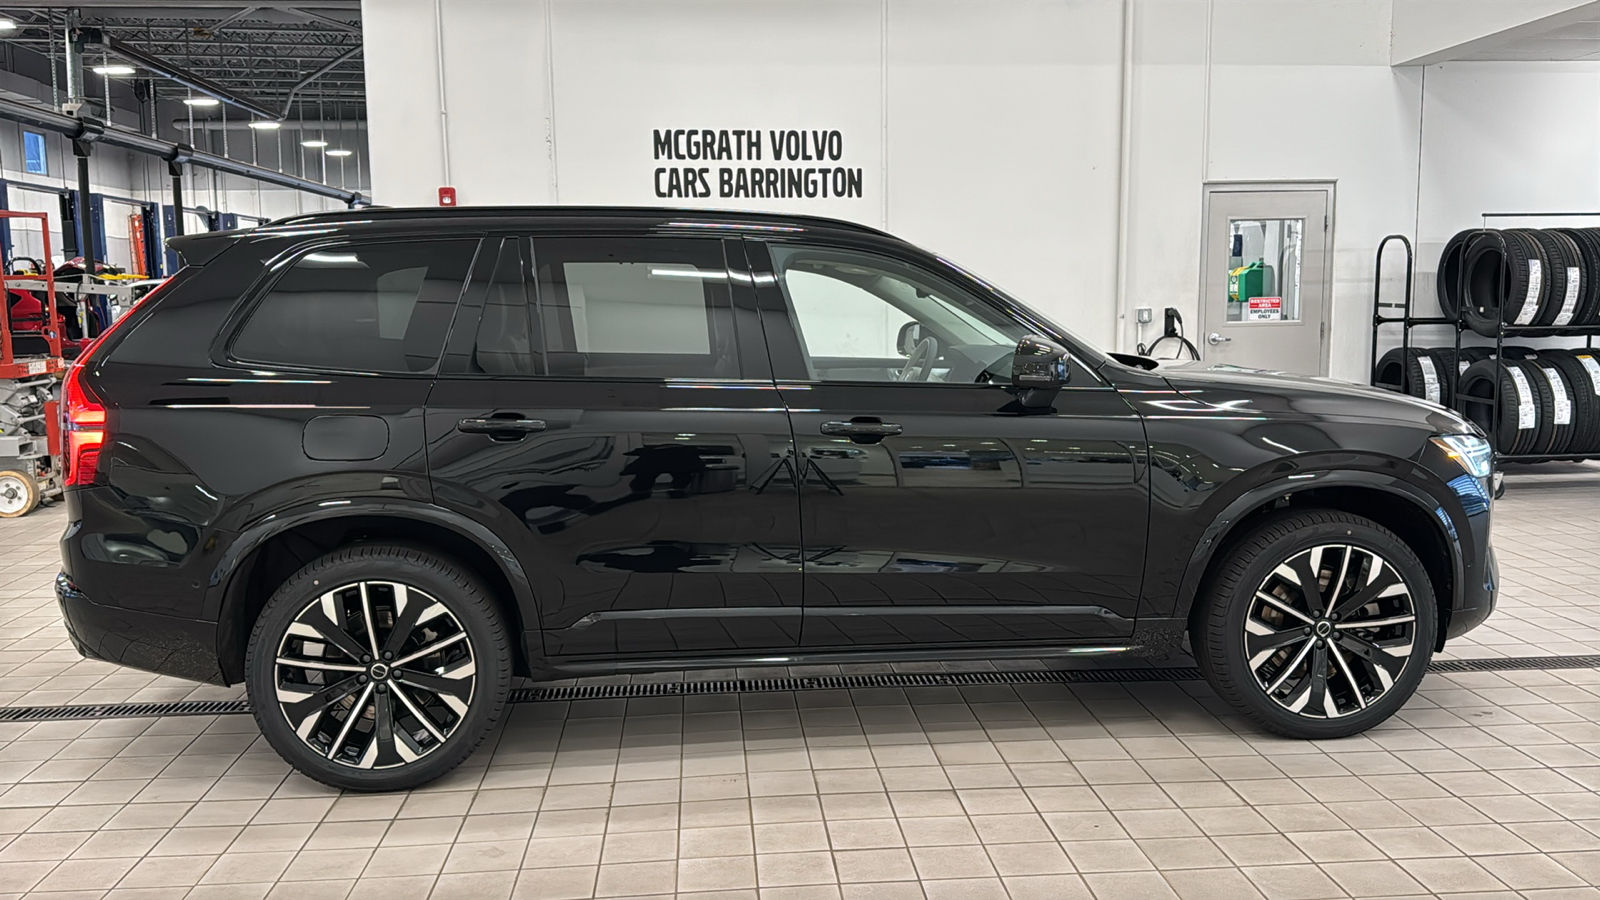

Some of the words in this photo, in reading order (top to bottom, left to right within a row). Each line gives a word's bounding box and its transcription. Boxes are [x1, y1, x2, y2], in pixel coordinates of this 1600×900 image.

[653, 129, 762, 161] MCGRATH
[769, 130, 843, 161] VOLVO
[654, 167, 712, 198] CARS
[718, 167, 863, 198] BARRINGTON
